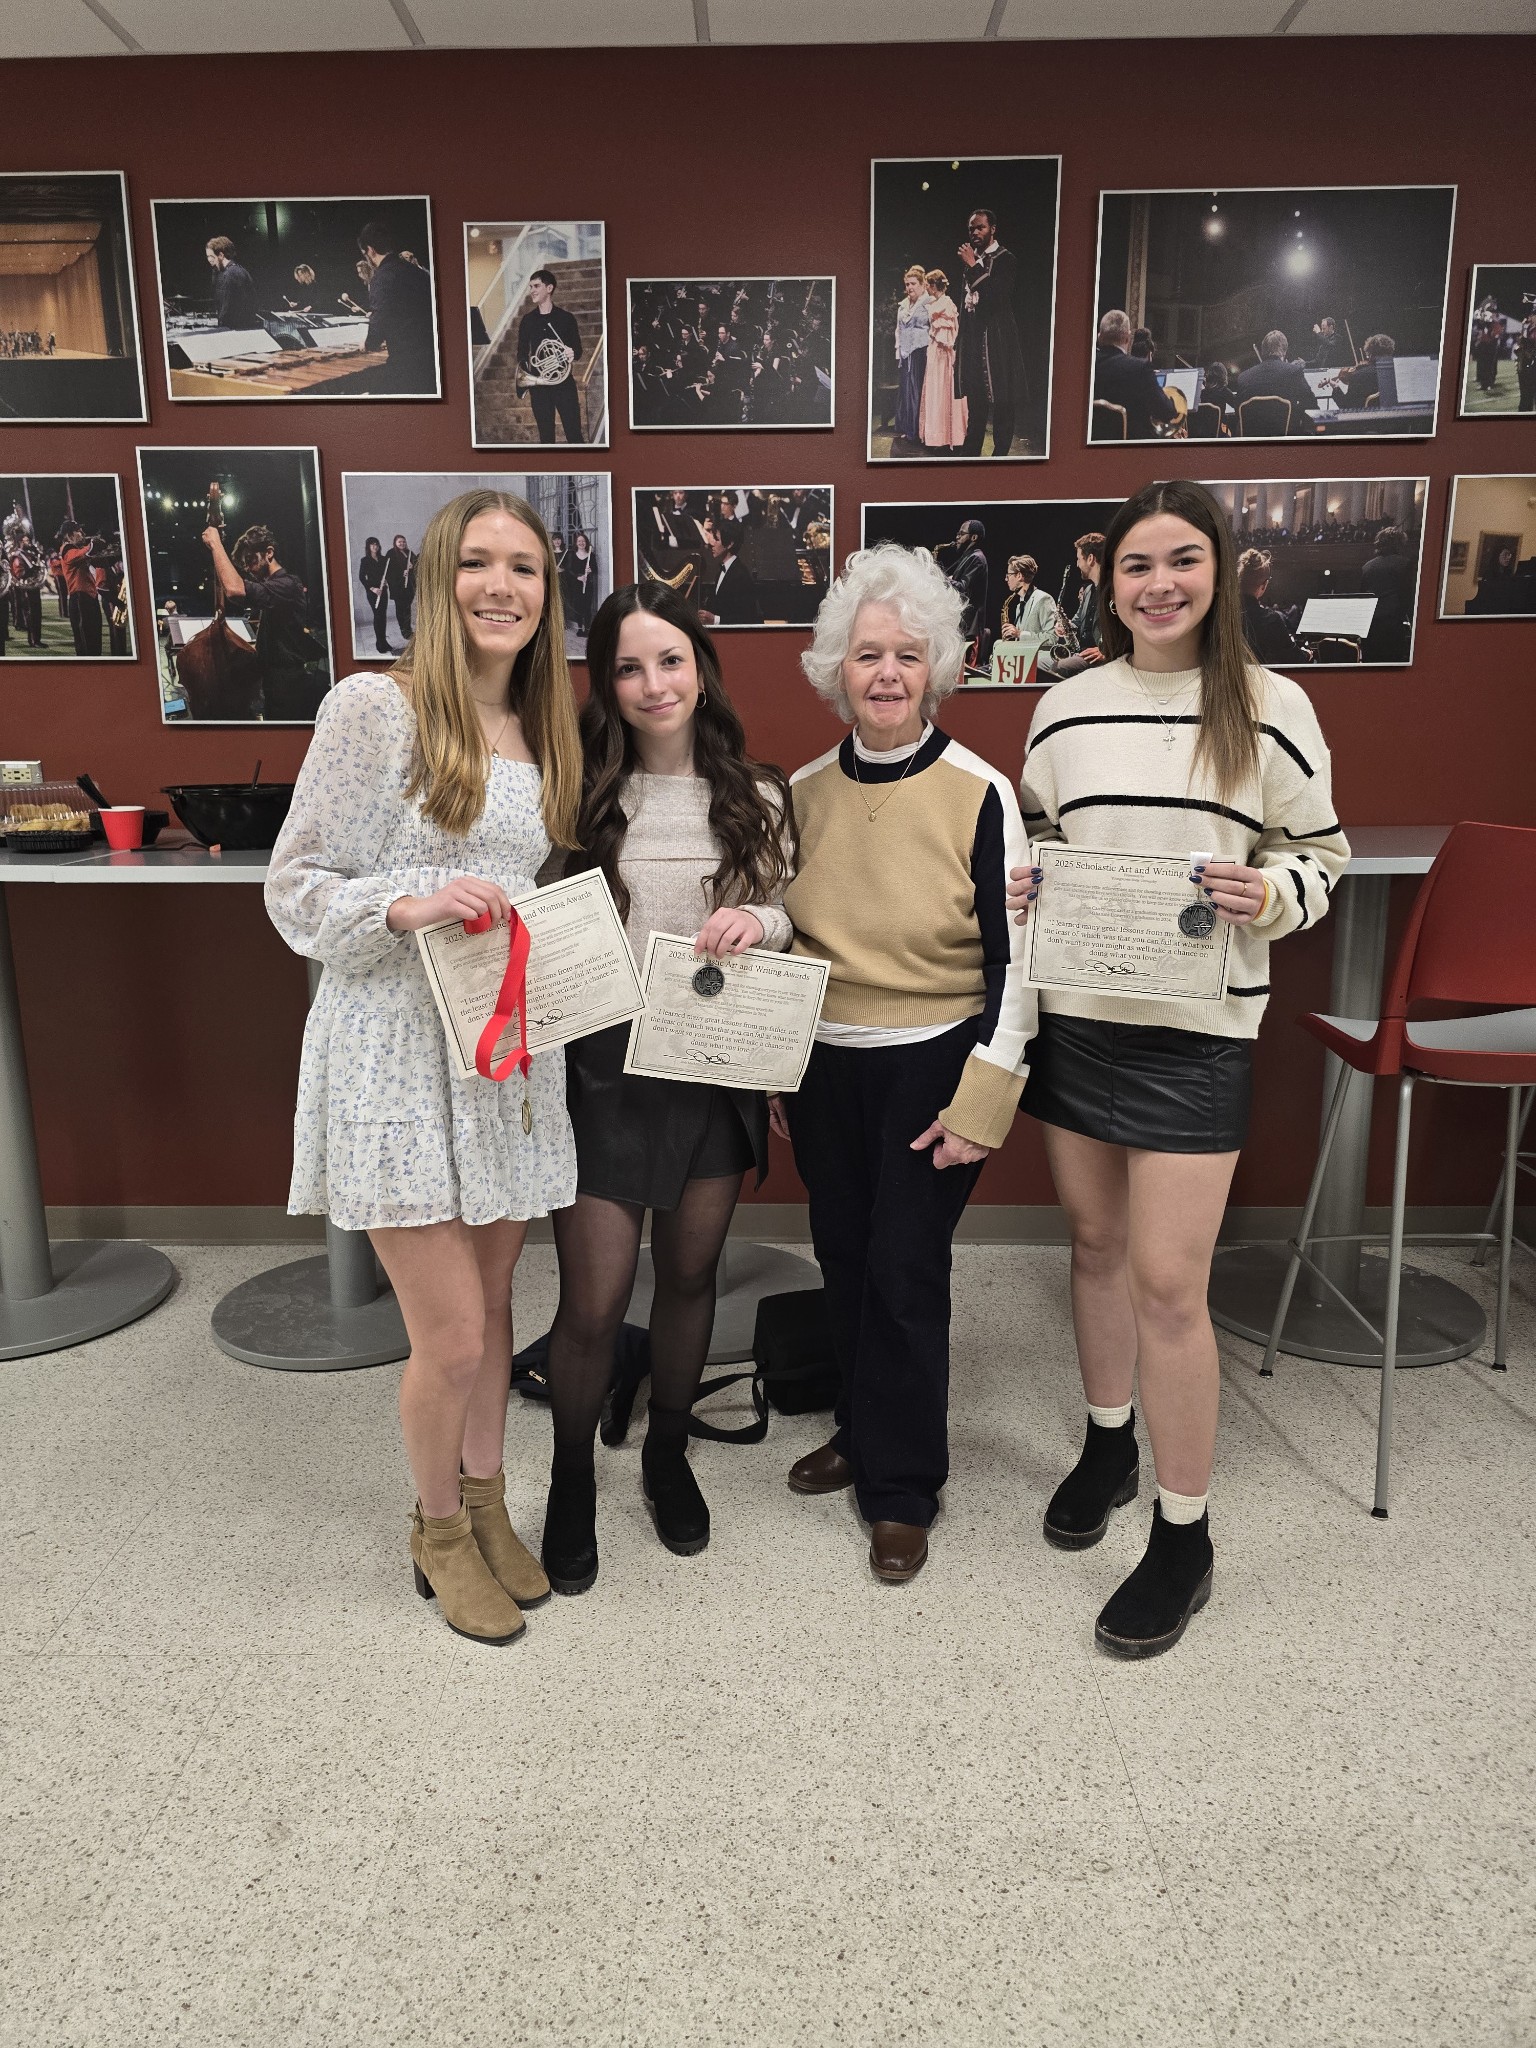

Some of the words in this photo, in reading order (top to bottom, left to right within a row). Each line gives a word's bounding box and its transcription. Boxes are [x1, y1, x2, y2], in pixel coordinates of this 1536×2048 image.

[997, 655, 1025, 684] YSU
[1054, 859, 1073, 867] 2025
[1075, 861, 1116, 871] Scholastic
[1134, 866, 1149, 874] and
[1152, 867, 1183, 877] Writing
[443, 931, 463, 945] 2025
[522, 909, 536, 920] and
[537, 899, 565, 915] Writing
[564, 889, 592, 905] Awards
[1056, 920, 1079, 928] learned
[1081, 923, 1100, 931] many
[1101, 925, 1118, 933] great
[1120, 926, 1143, 934] lessons
[1089, 949, 1107, 957] doing
[1105, 942, 1124, 950] might
[1173, 948, 1197, 956] chance
[668, 950, 685, 959] 2025
[725, 960, 737, 968] Art
[739, 963, 753, 971] and
[754, 965, 782, 977] Writing
[782, 970, 810, 980] Awards
[460, 1007, 471, 1016] the
[472, 1002, 486, 1012] least
[533, 982, 547, 992] that
[548, 979, 561, 988] you
[561, 975, 573, 983] can
[573, 970, 584, 978] fail
[592, 962, 607, 971] what
[607, 957, 620, 967] you
[468, 990, 494, 1004] learned
[533, 970, 556, 983] lessons
[557, 965, 573, 975] from
[573, 962, 583, 970] my
[603, 950, 614, 958] not
[466, 1012, 483, 1023] don't
[525, 992, 545, 1005] might
[555, 985, 568, 995] well
[569, 980, 582, 990] take
[588, 970, 610, 983] chance
[533, 1001, 549, 1011] what
[551, 997, 563, 1006] you
[662, 1009, 685, 1018] learned
[704, 1016, 719, 1024] great
[721, 1019, 742, 1027] lessons
[652, 1024, 668, 1032] don't
[706, 1033, 724, 1041] might
[764, 1041, 785, 1049] chance
[690, 1039, 708, 1047] doing
